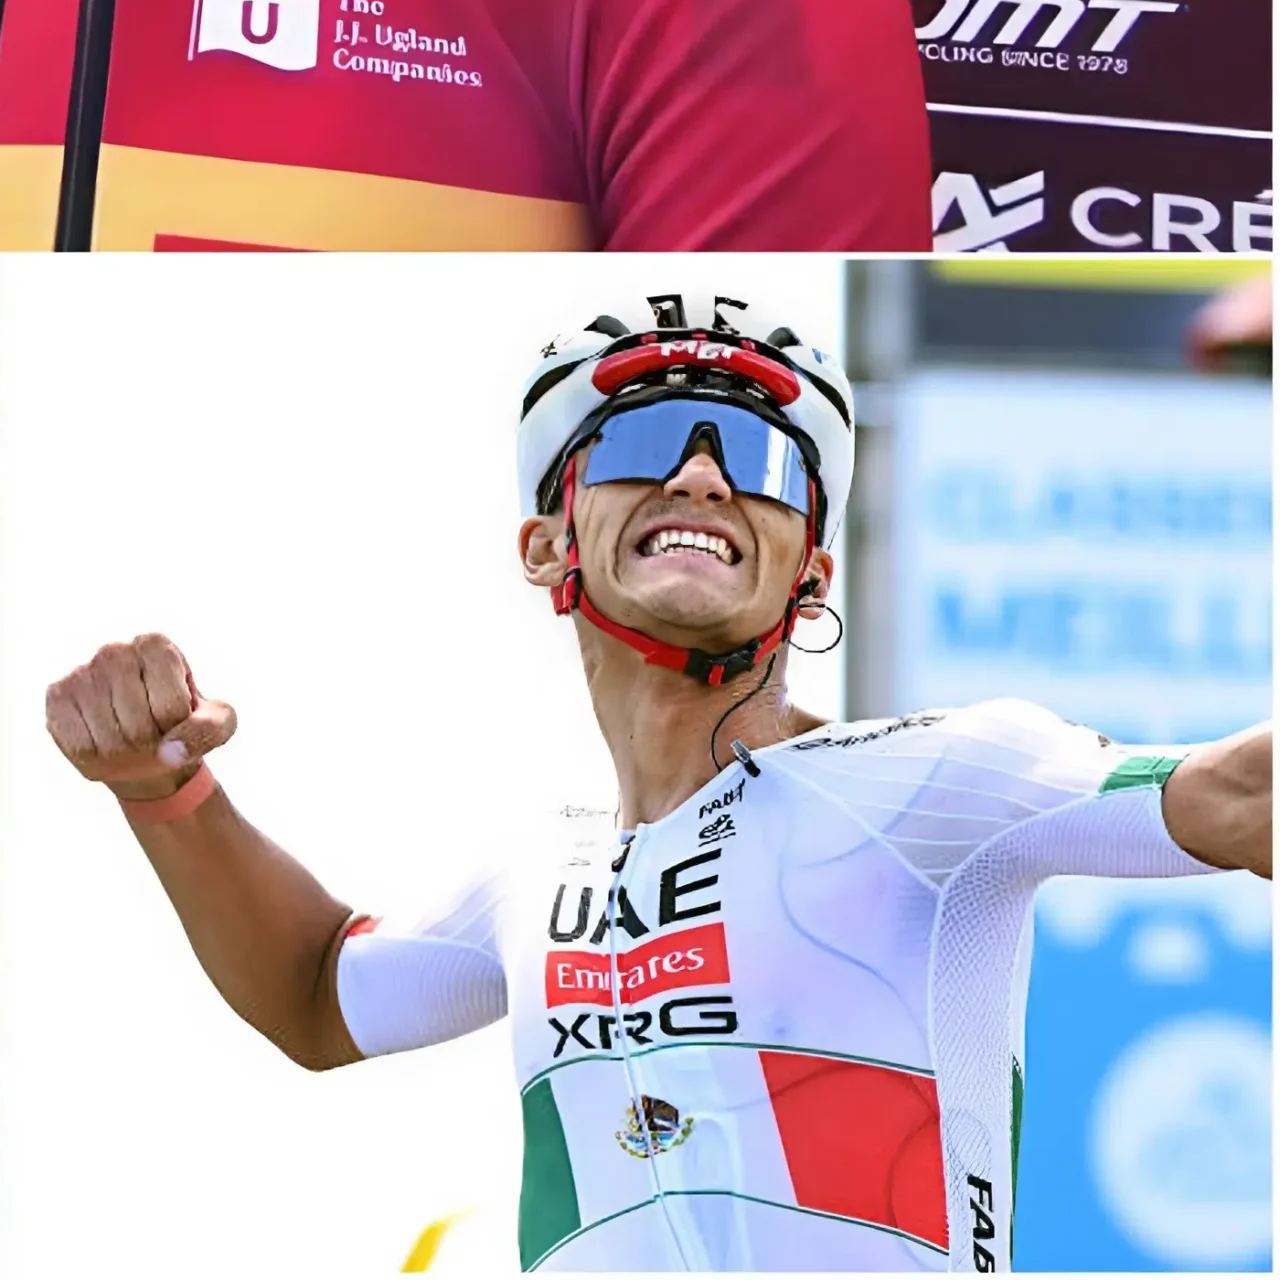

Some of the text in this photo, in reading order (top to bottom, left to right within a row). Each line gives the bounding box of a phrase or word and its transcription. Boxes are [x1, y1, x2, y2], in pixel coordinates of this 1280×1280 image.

[240, 0, 280, 46] U
[547, 847, 723, 946] UAE
[547, 995, 738, 1058] XRG
